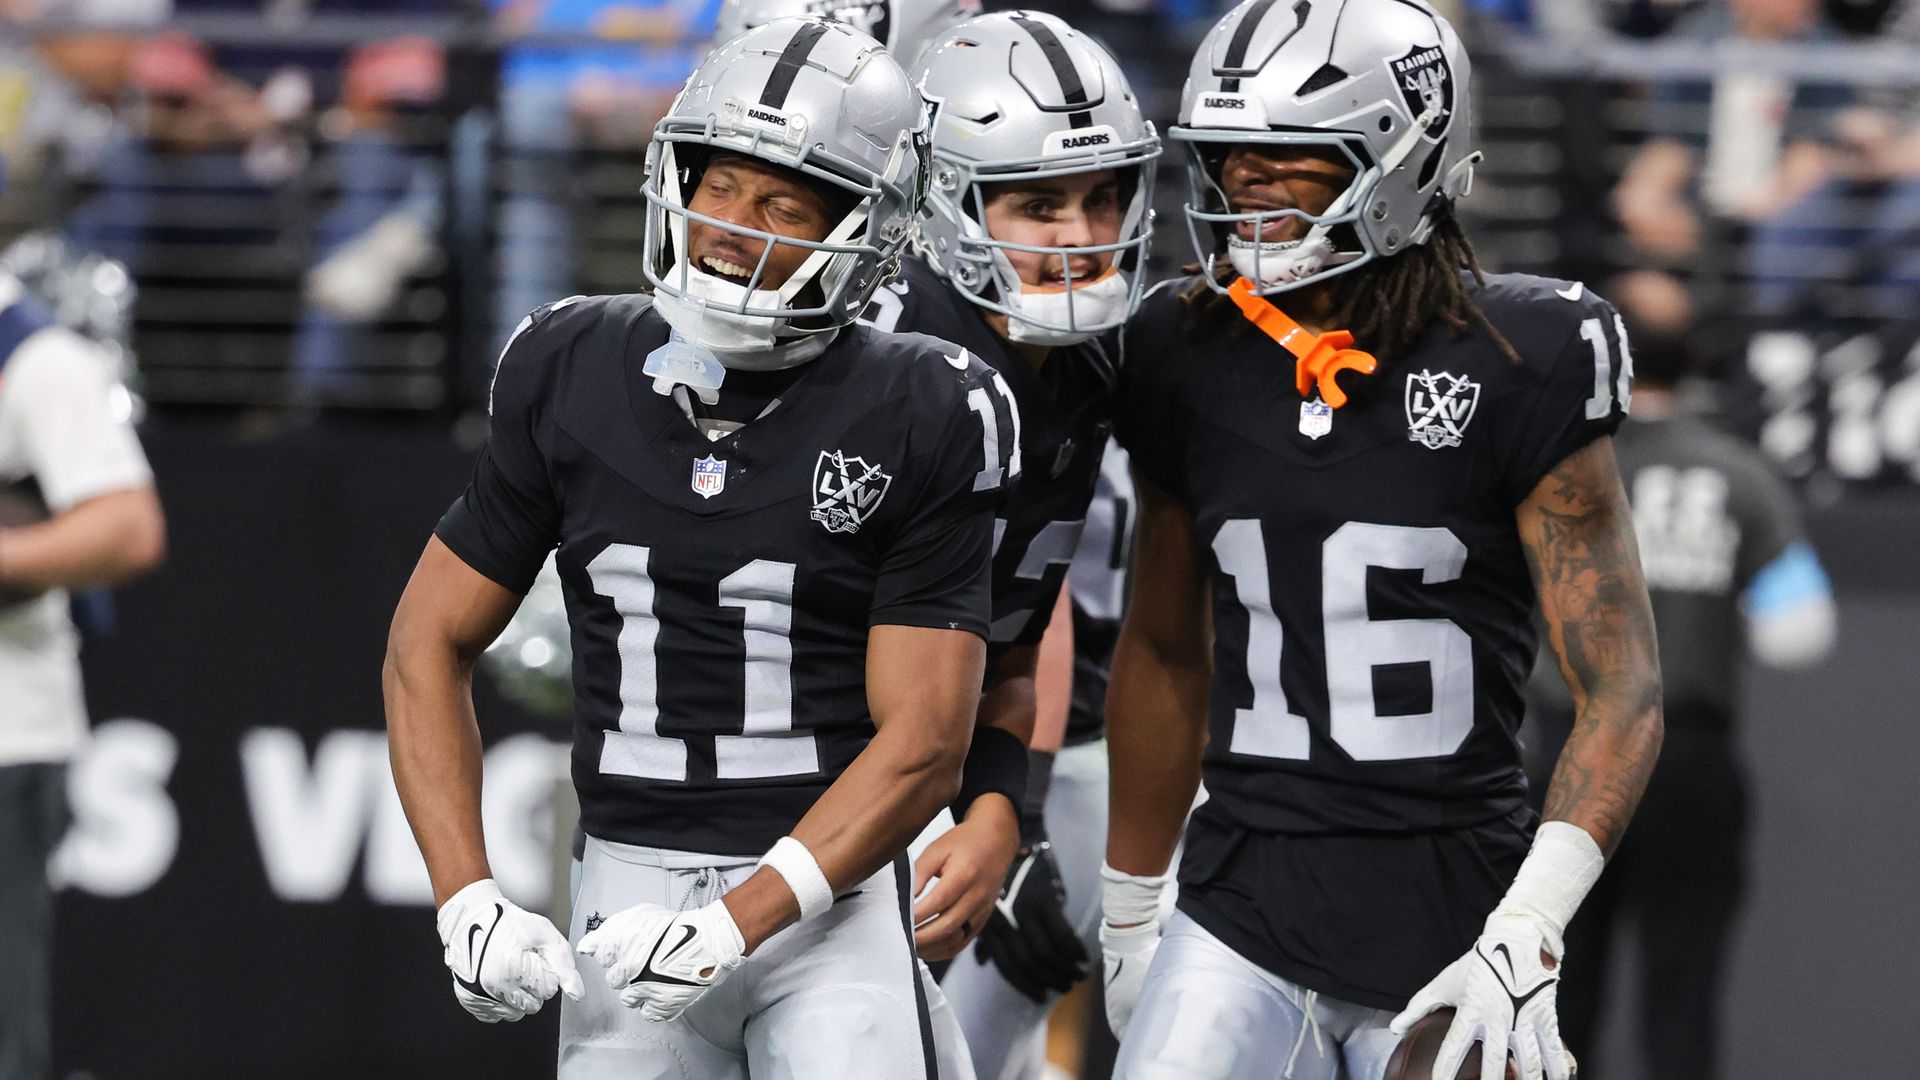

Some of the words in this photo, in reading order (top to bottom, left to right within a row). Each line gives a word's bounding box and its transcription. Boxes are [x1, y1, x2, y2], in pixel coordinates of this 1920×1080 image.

[1396, 47, 1442, 73] RAIDERS
[1204, 98, 1246, 110] RAIDERS
[747, 109, 788, 127] RAIDERS
[1062, 133, 1111, 149] RAIDERS
[967, 372, 1022, 492] 11
[697, 473, 720, 491] NFL
[1211, 518, 1475, 761] 16
[585, 542, 820, 782] 11
